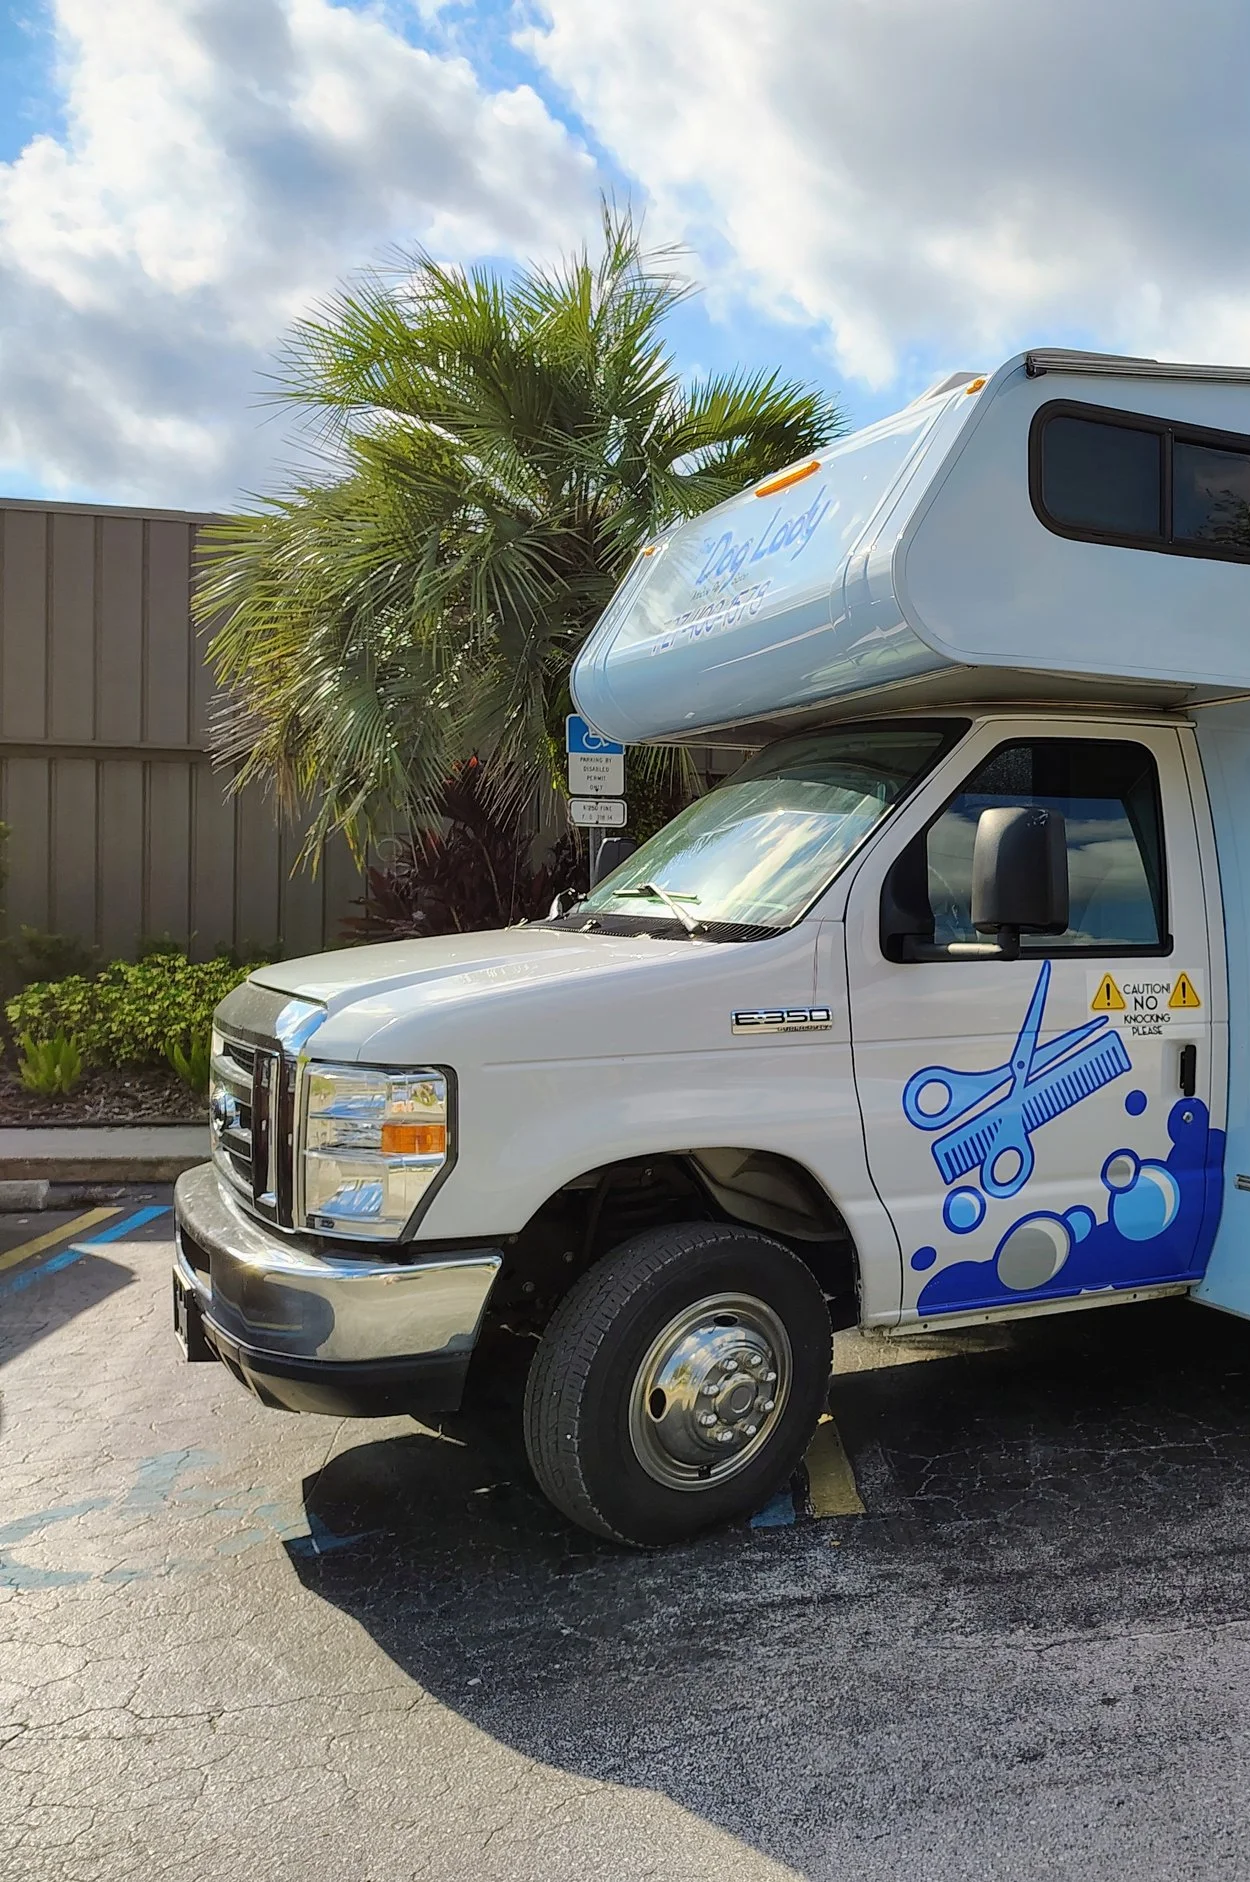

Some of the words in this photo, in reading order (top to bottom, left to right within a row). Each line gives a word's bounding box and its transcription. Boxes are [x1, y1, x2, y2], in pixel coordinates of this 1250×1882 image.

[1122, 983, 1171, 995] CAUTION!
[1134, 995, 1158, 1011] NO
[1123, 1013, 1171, 1025] KNOCKING
[1132, 1025, 1163, 1036] PLEASE
